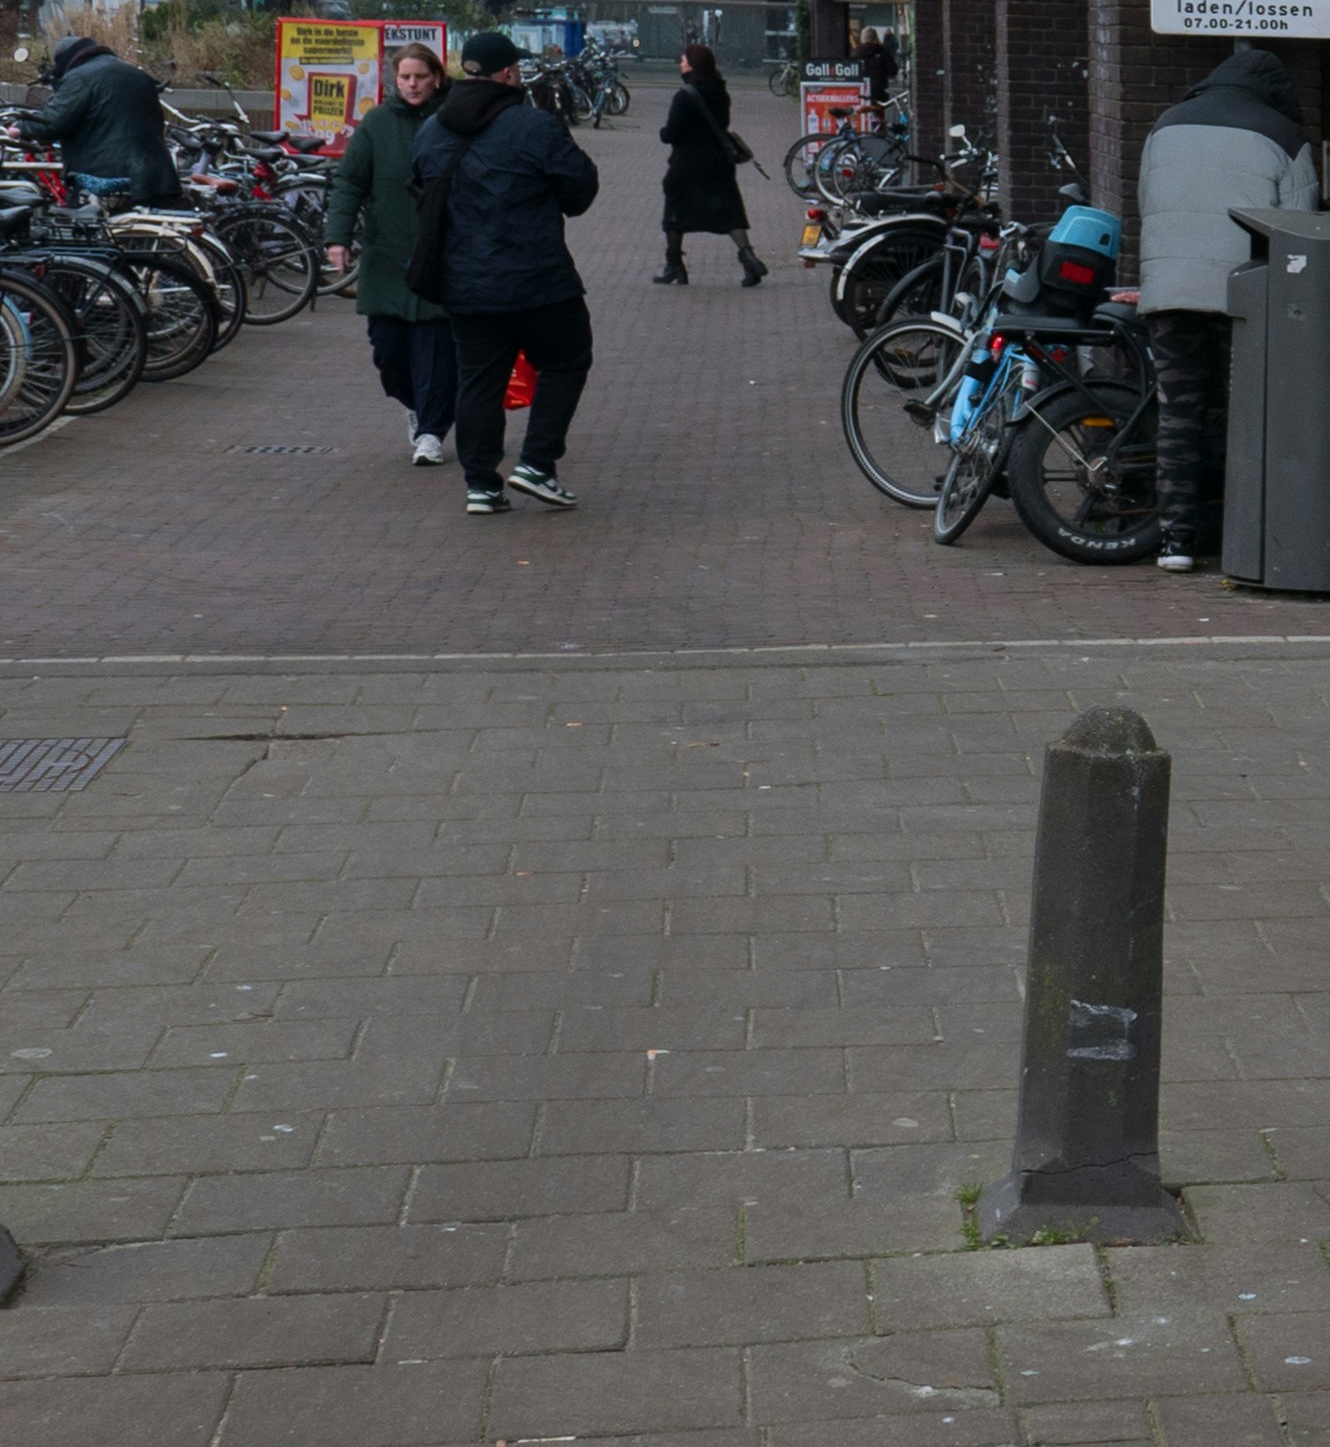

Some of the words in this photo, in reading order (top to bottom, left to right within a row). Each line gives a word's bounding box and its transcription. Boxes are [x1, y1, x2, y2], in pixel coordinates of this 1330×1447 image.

[1177, 0, 1313, 17] laden/lossen
[1184, 17, 1289, 30] 07.00-21.00h
[805, 62, 830, 76] Gall
[835, 62, 859, 76] Gall
[313, 79, 345, 98] Dirk
[1058, 527, 1136, 550] KENDA
